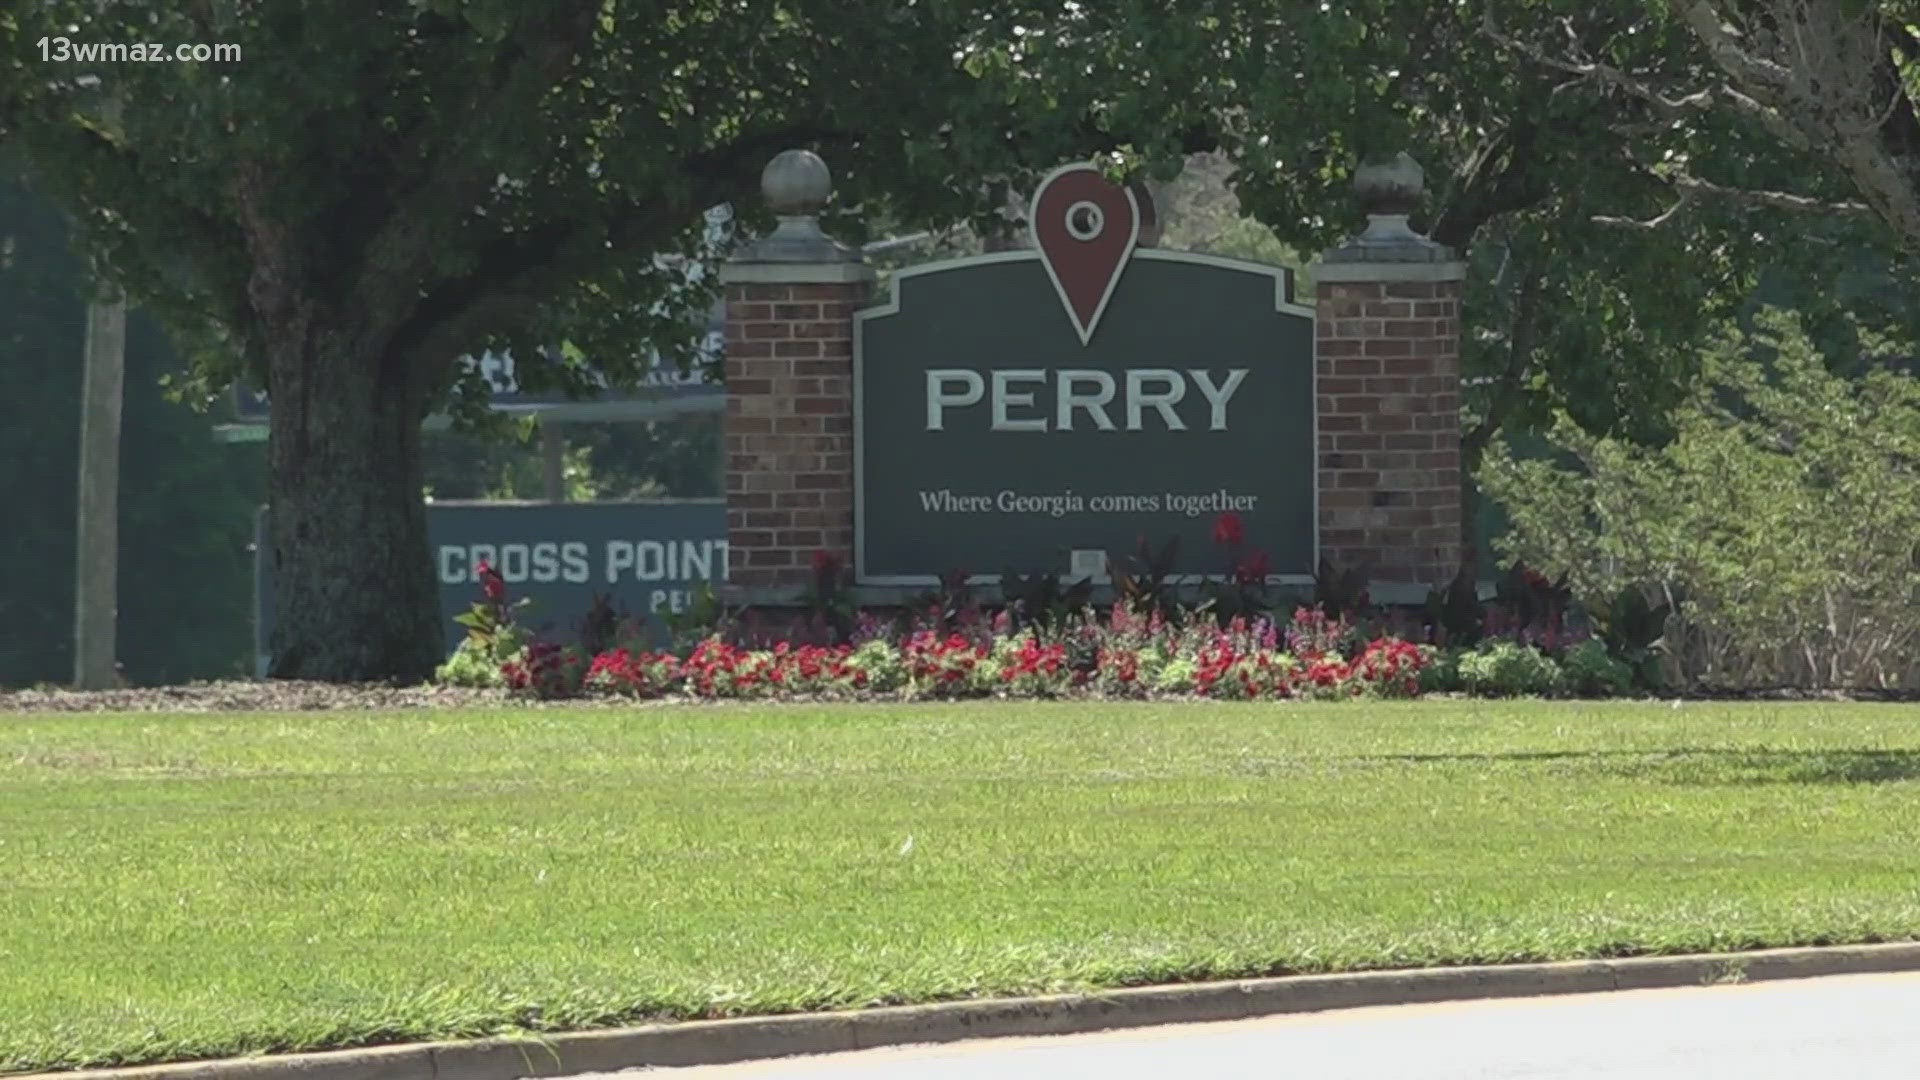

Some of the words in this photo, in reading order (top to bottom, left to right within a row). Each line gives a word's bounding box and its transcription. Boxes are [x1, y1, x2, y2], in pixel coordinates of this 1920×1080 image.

[925, 368, 1250, 432] PERRY
[920, 490, 992, 512] Where
[997, 490, 1084, 517] Georgia
[1090, 496, 1159, 512] comes
[1166, 489, 1257, 517] together
[440, 542, 590, 584] CROSS
